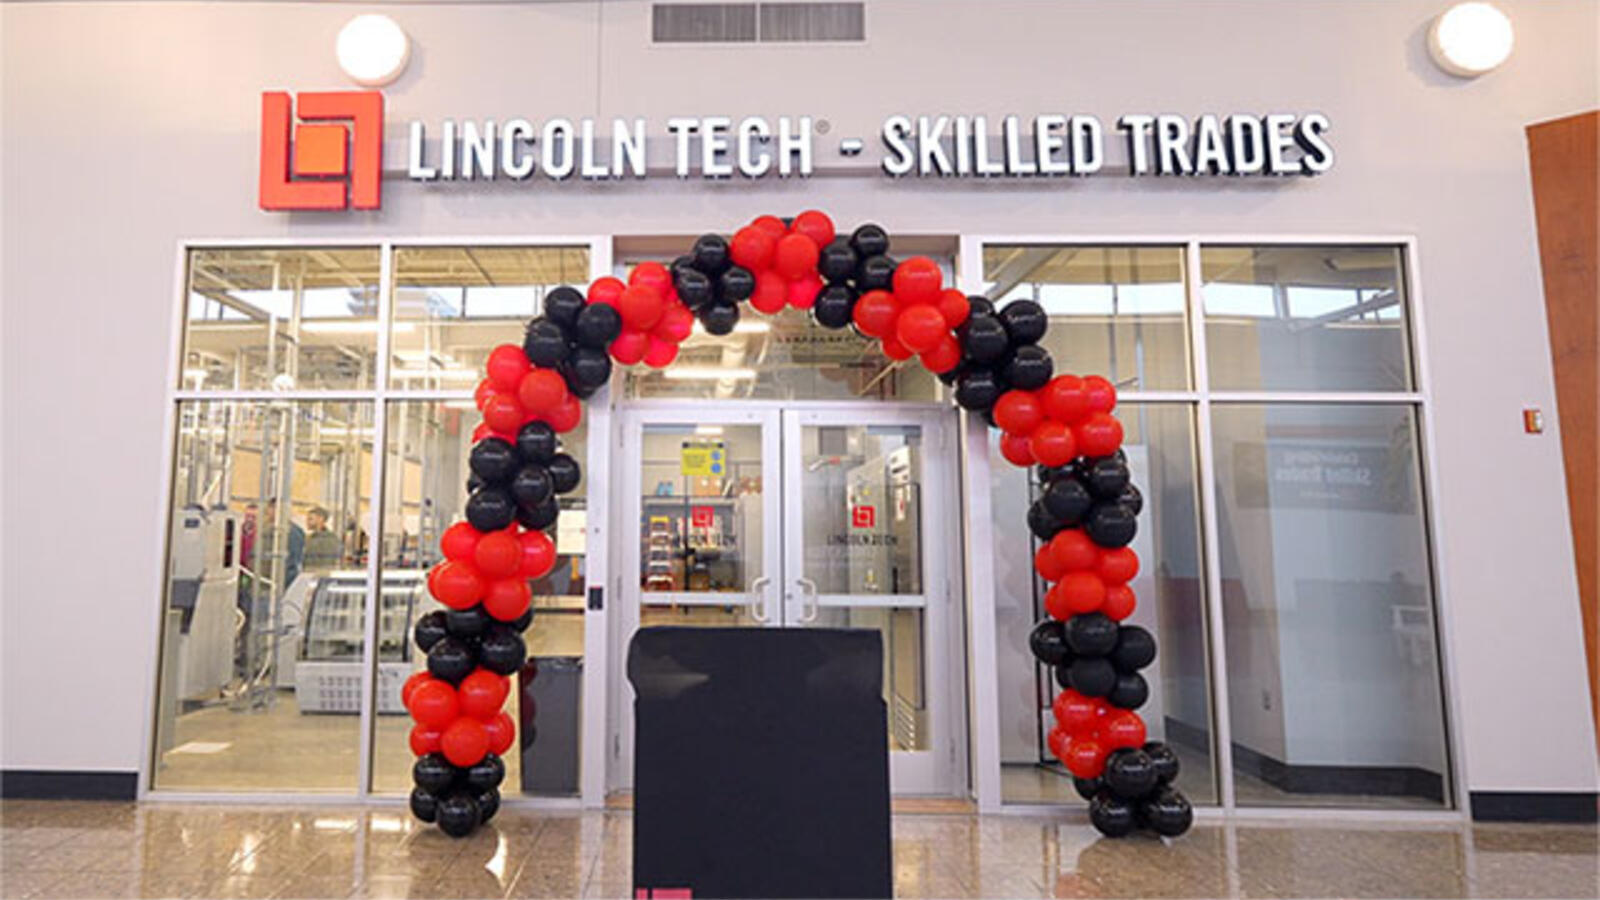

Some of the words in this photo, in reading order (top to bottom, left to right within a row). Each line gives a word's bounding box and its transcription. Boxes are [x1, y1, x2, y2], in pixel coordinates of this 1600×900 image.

[408, 118, 647, 181] LINCOLN
[882, 114, 1103, 178] SKILLED
[1117, 112, 1335, 178] TRADES
